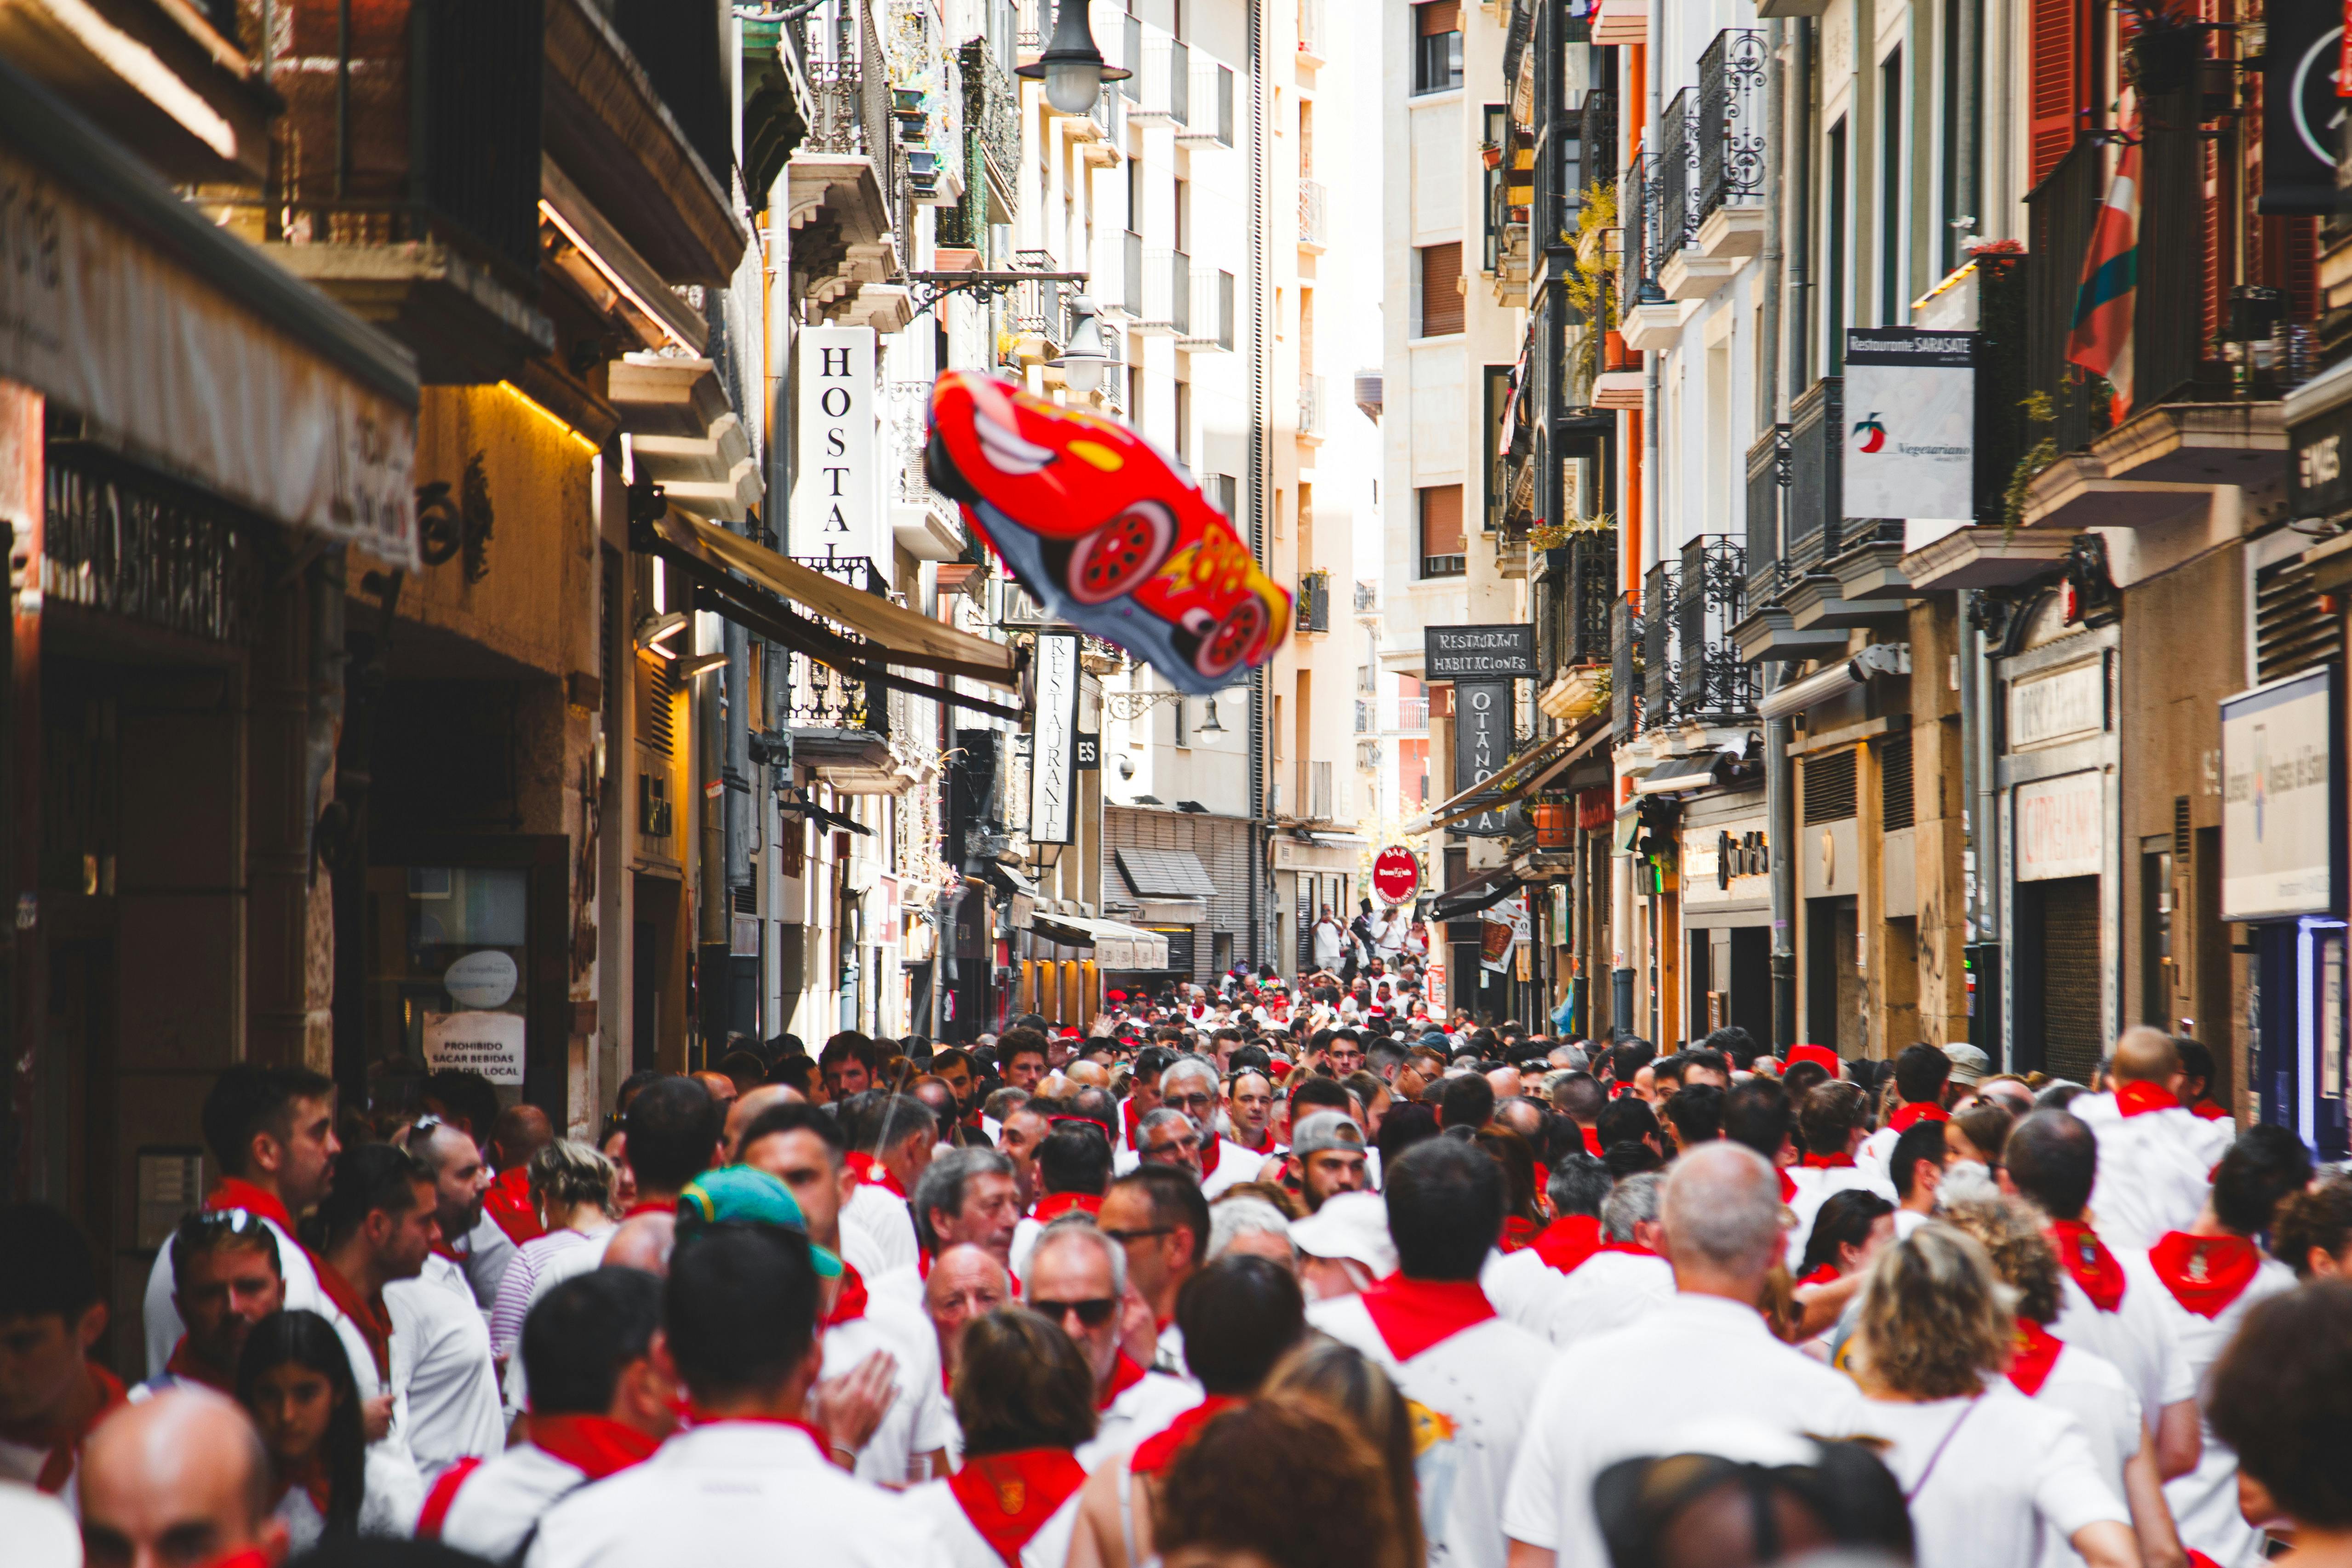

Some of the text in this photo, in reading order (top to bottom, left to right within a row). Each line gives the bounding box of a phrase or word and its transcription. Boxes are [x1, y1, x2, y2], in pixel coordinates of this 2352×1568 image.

[1849, 336, 1971, 353] Restaurante SARASATE
[1898, 442, 1971, 457] Vegetariano
[819, 348, 853, 572] HOSTAL
[1439, 633, 1520, 649] RESTAURANT
[1433, 656, 1527, 670] HABITACIONES
[1043, 637, 1066, 841] RESTAURANTE
[1472, 692, 1493, 784] OTANO
[1385, 847, 1407, 858] BAR
[1377, 887, 1415, 904] RESTAURANTE
[444, 1042, 503, 1051] PROHIBIDO
[432, 1054, 514, 1063] SACAR BEBIDAS
[484, 1067, 519, 1076] LOCAL
